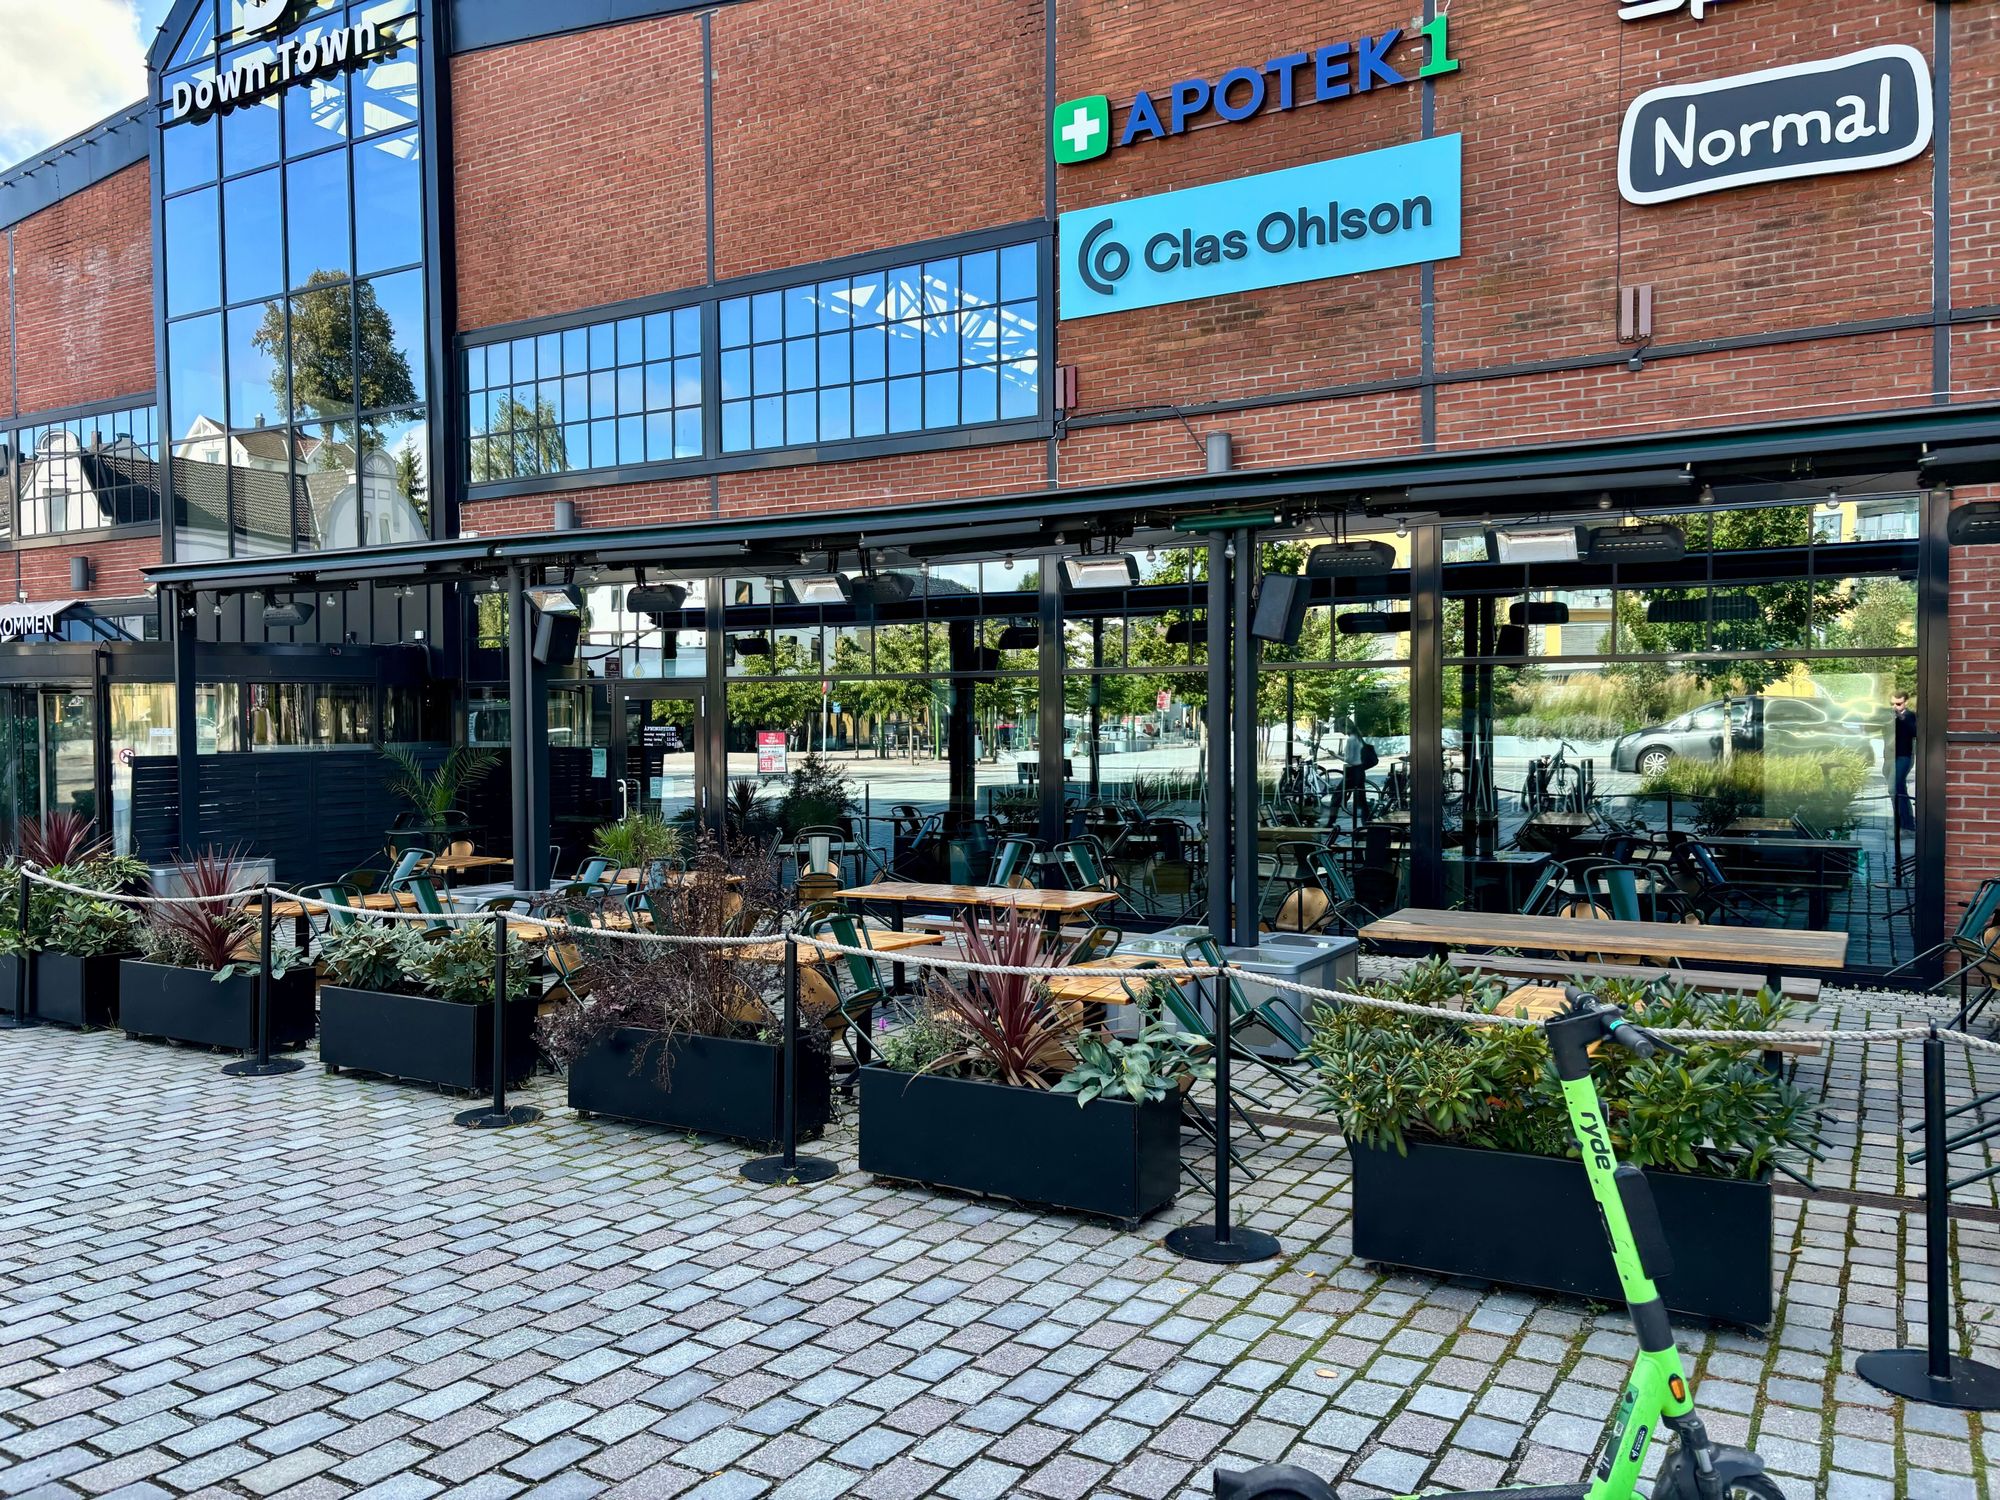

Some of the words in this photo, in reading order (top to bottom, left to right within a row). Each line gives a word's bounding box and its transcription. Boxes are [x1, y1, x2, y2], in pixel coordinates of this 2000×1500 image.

[172, 60, 266, 119] Down
[277, 17, 376, 81] Town
[1120, 29, 1405, 145] APOTEK
[1419, 14, 1460, 78] 1
[1654, 73, 1891, 176] Normal
[1143, 227, 1249, 273] Clas
[1256, 194, 1433, 254] Ohlson
[0, 613, 54, 636] OMMEN
[1579, 1111, 1612, 1171] ryde
